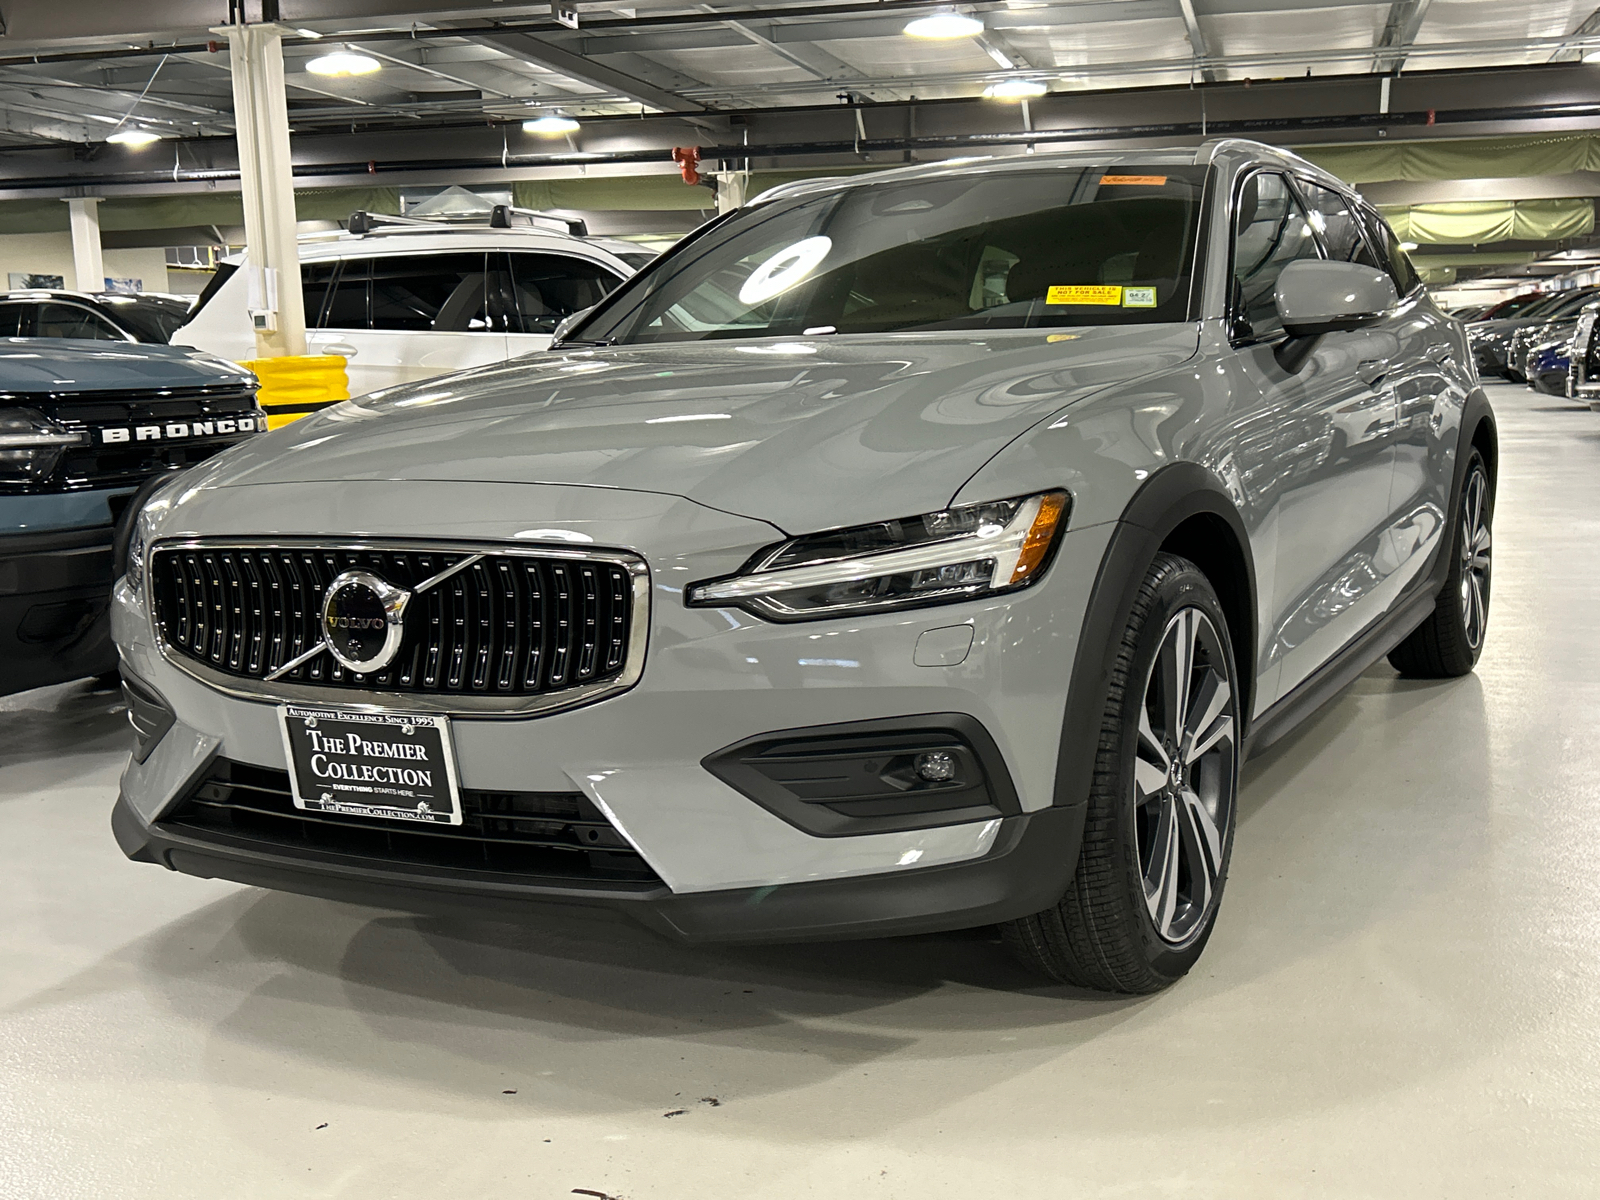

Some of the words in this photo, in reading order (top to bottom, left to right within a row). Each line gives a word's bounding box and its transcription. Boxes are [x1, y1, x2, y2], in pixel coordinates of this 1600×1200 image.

[102, 418, 254, 443] BRONCO
[327, 616, 385, 629] VOLVO
[289, 708, 336, 719] AUTOMOTIVE
[336, 711, 384, 723] EXCELLENCE
[385, 715, 409, 725] SINCE
[411, 717, 434, 727] 1995
[306, 729, 346, 754] THE
[346, 733, 429, 761] PREMIER
[311, 754, 433, 788] COLLECTION
[332, 783, 373, 793] EVERYTHING
[374, 787, 397, 795] STARTS
